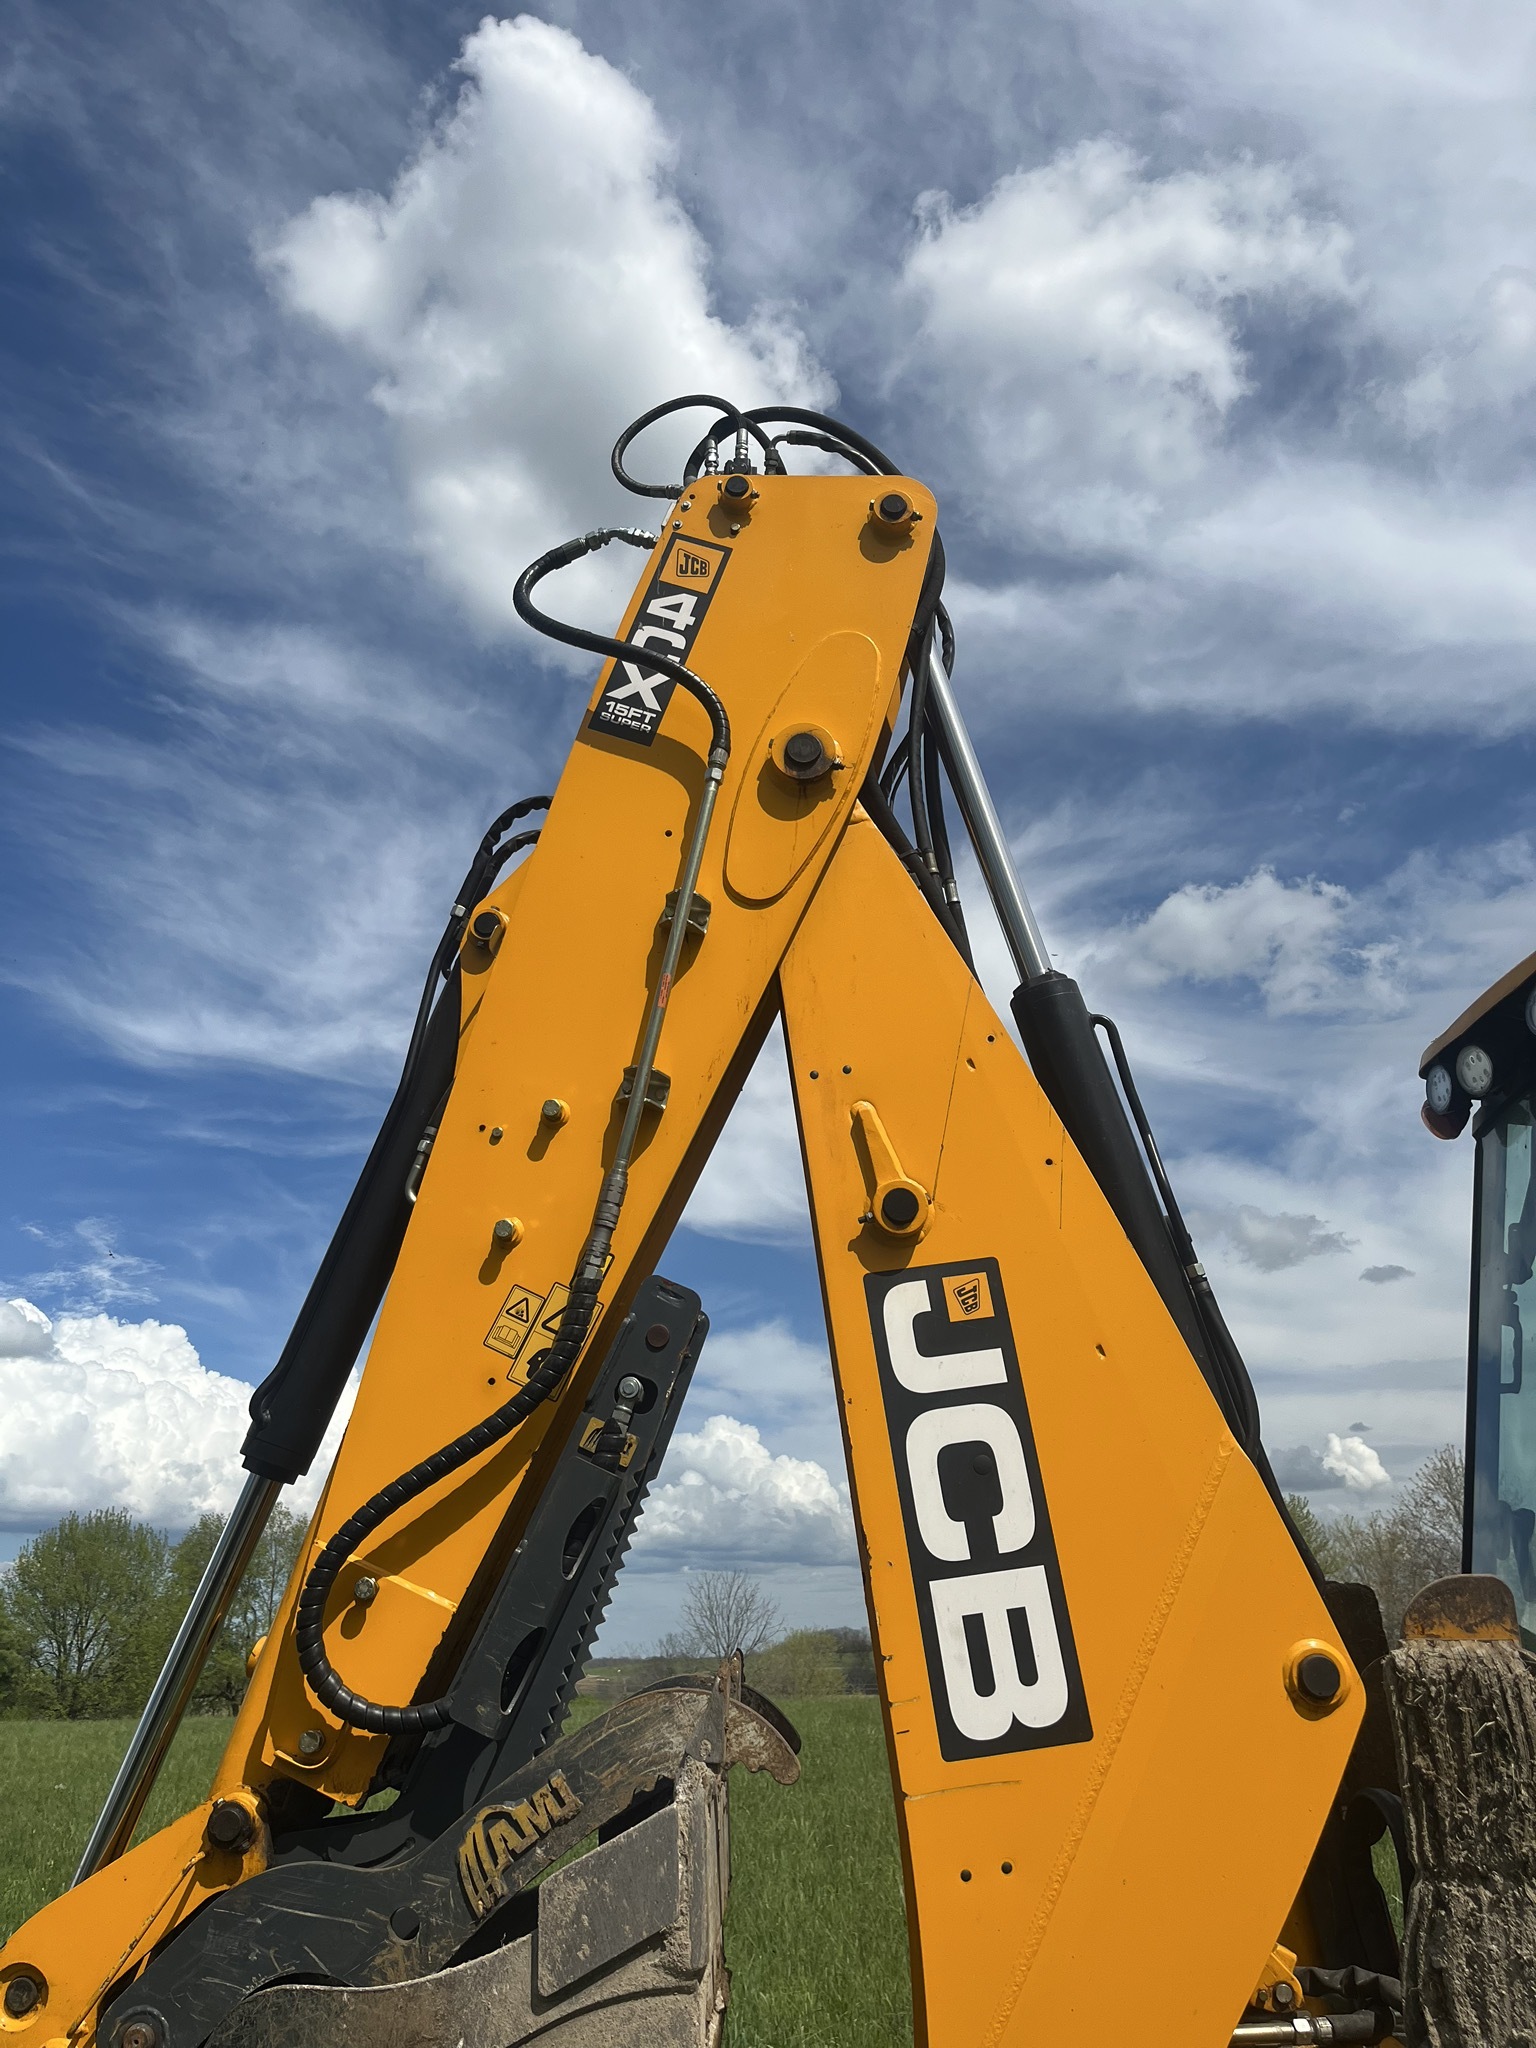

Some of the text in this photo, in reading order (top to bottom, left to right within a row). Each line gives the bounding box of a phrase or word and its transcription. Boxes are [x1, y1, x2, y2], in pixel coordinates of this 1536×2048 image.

[678, 553, 707, 576] JCB
[600, 711, 651, 734] SUPER
[605, 701, 657, 724] 15FT
[957, 1285, 978, 1312] JCB
[882, 1279, 1069, 1742] JCB
